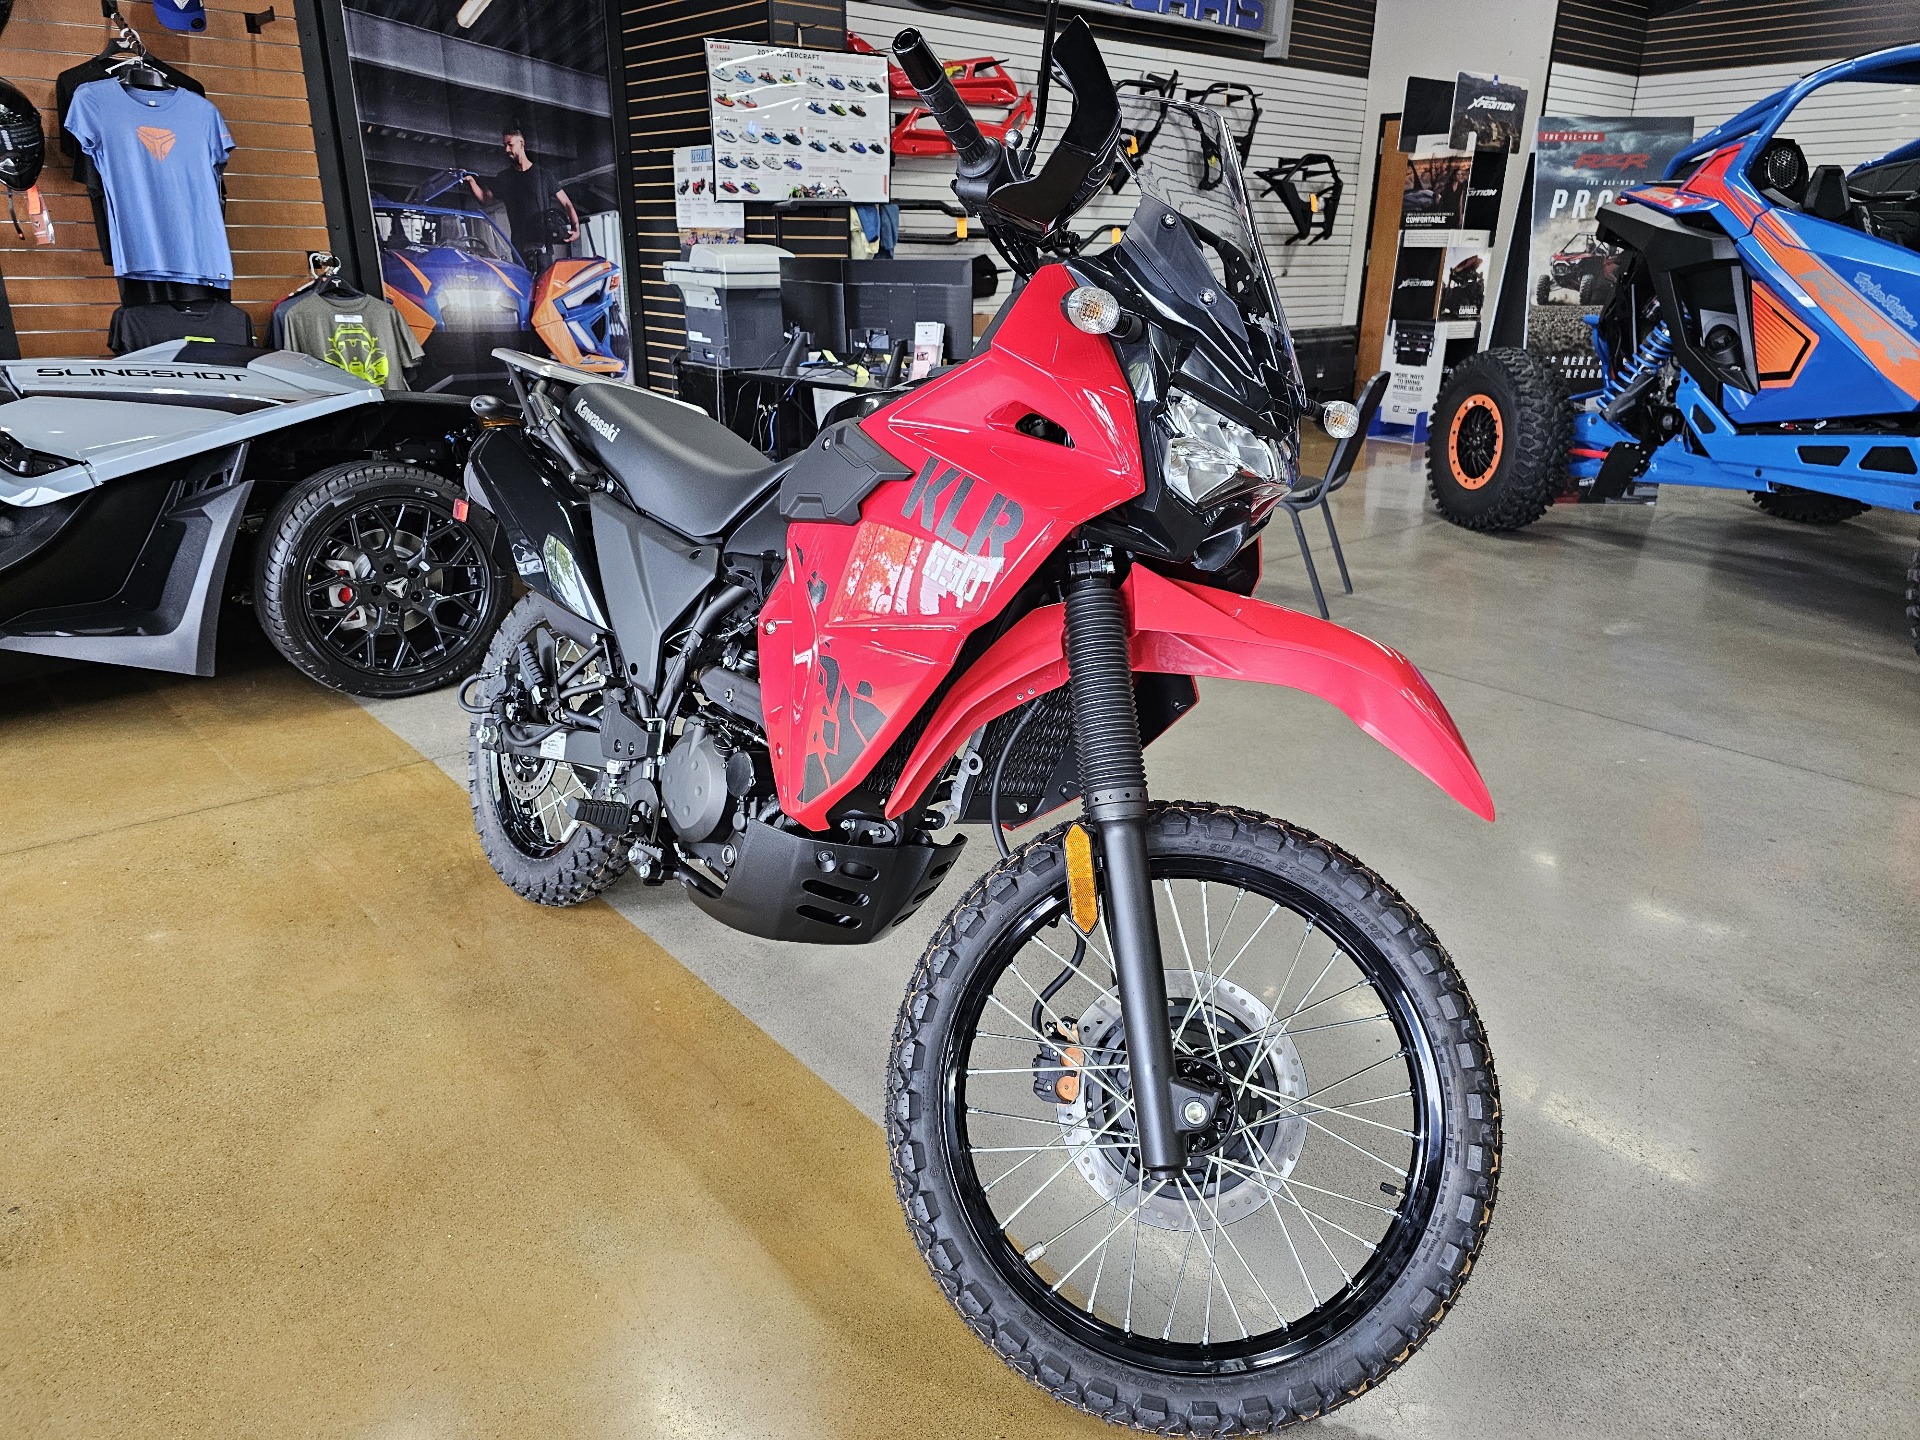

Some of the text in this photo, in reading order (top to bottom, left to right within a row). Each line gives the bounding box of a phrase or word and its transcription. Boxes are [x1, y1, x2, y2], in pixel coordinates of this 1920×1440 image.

[1574, 153, 1649, 169] RZR
[36, 368, 248, 381] SLINGSHOT
[574, 398, 621, 443] Kawasaki
[901, 456, 1025, 573] KLR
[922, 540, 987, 603] 650
